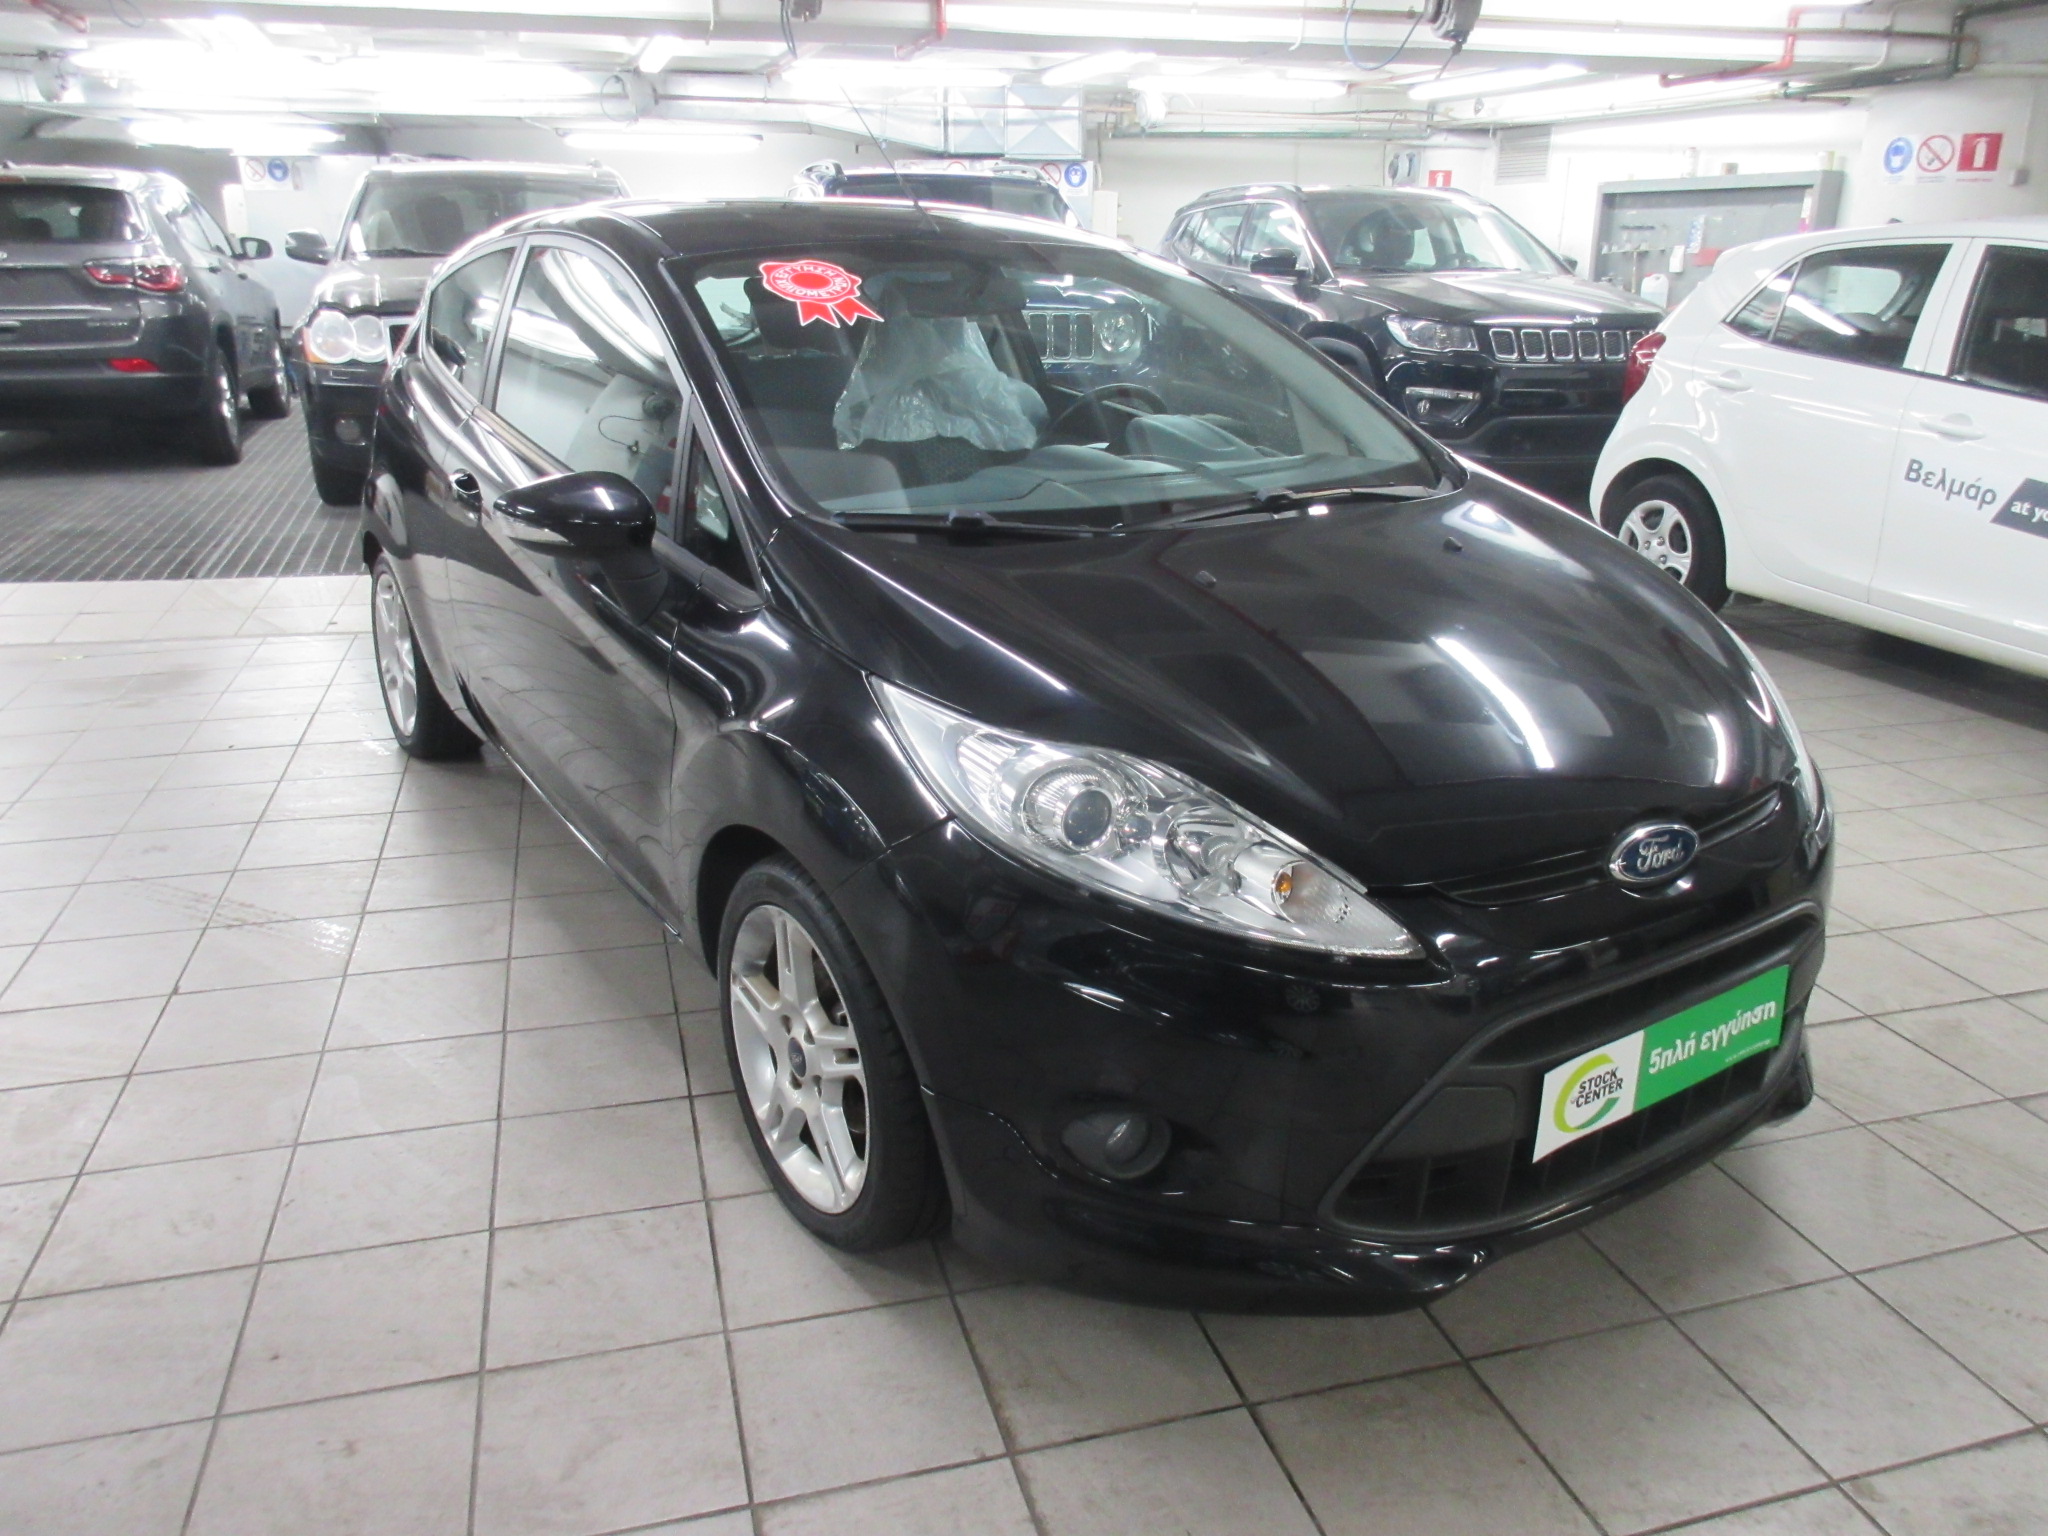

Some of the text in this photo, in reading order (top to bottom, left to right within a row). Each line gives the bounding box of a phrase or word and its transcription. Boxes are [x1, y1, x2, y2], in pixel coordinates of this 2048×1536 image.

[1904, 458, 1997, 510] Βελμάρ
[2010, 501, 2031, 516] at
[1637, 834, 1684, 872] Ford
[1648, 1032, 1696, 1074] 5πλή
[1700, 1001, 1776, 1052] εγγύηση
[1575, 1078, 1623, 1108] CENTER
[1578, 1066, 1618, 1094] STOCK
